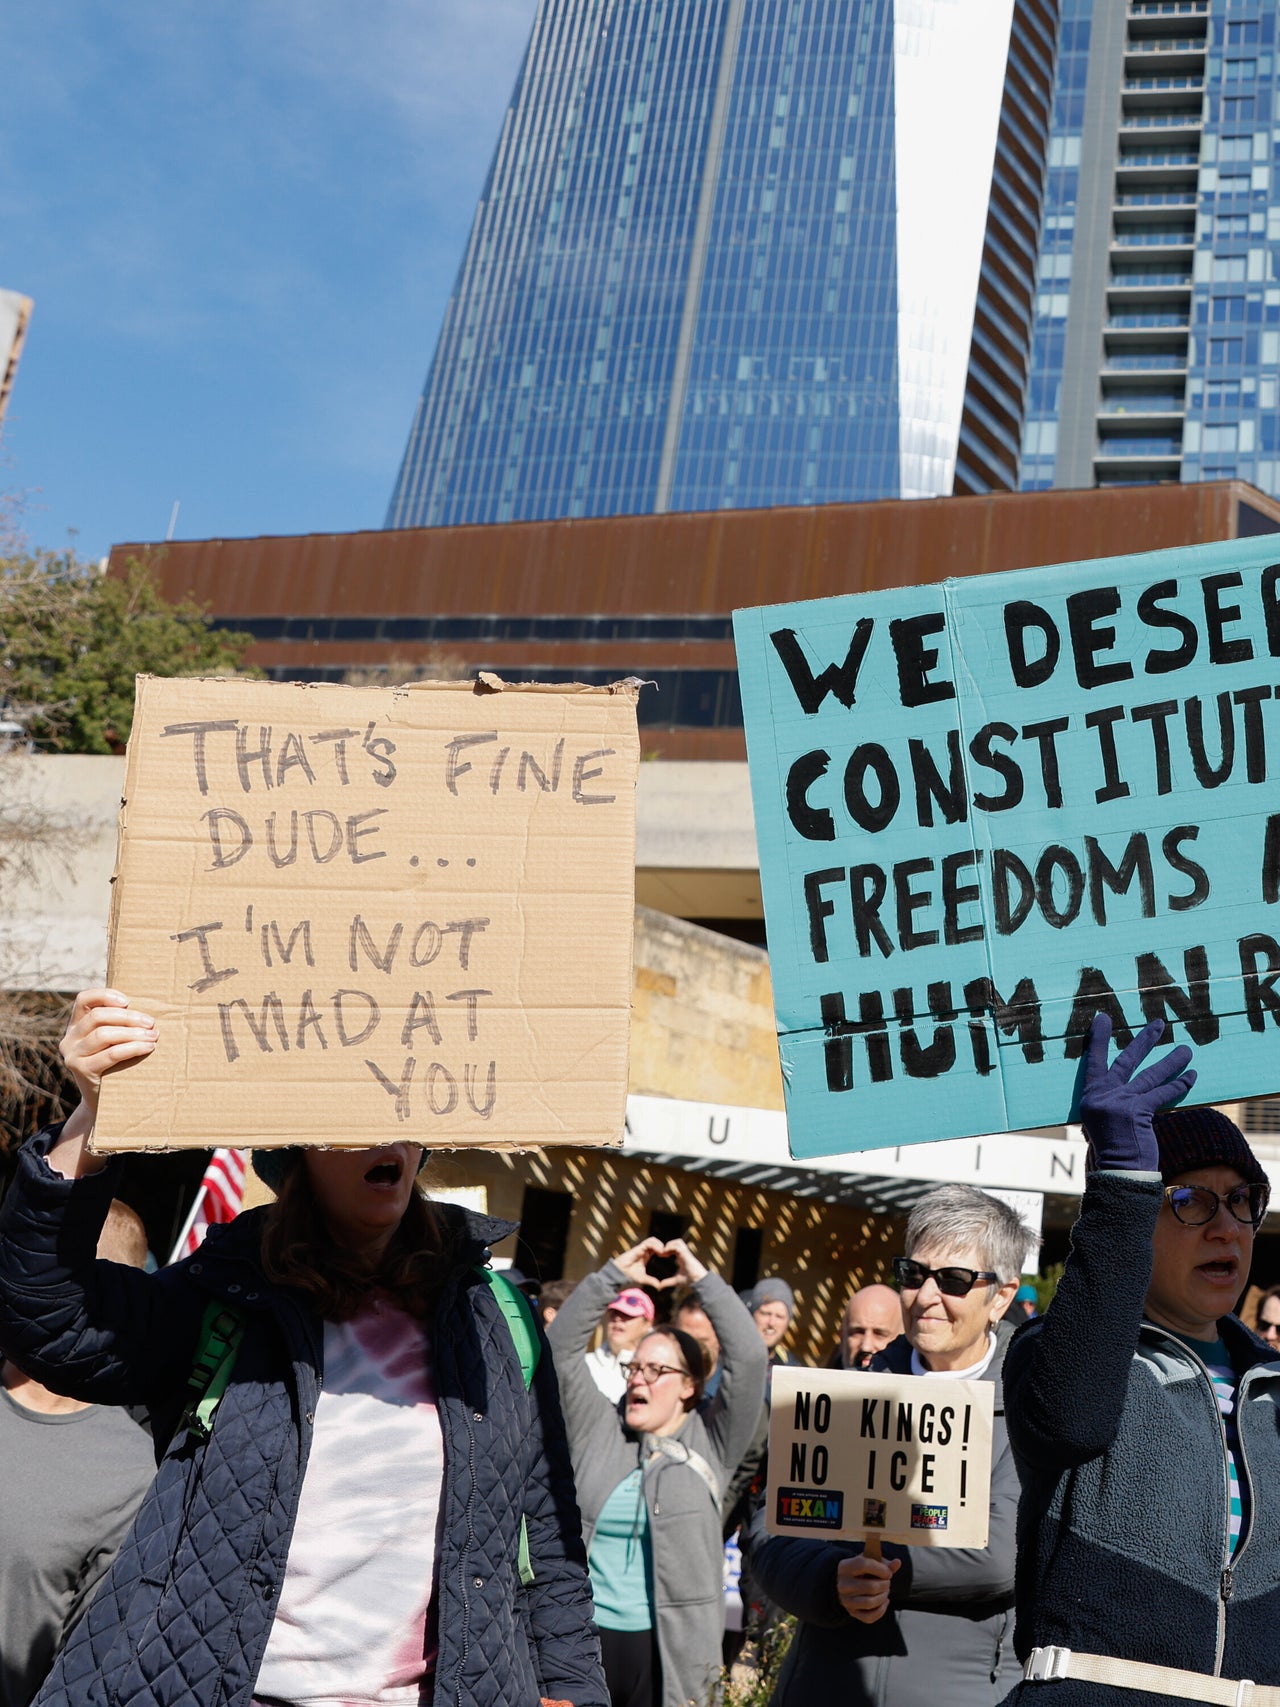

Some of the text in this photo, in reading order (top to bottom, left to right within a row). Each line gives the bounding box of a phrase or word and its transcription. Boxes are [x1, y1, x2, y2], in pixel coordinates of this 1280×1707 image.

[770, 611, 955, 715] WE
[159, 719, 617, 804] THAT'S FINE
[200, 807, 476, 872] DUDE...
[803, 824, 1211, 963] FREEDOMS
[169, 904, 491, 993] I'M NOT
[217, 987, 493, 1063] MAD AT
[820, 945, 1220, 1093] HUMAN
[365, 1056, 497, 1121] YOU
[794, 1391, 971, 1451] NO KINGS!
[790, 1442, 828, 1485] NO
[781, 1497, 839, 1519] TEXAN
[913, 1516, 937, 1525] PEACE
[920, 1508, 947, 1517] PEOPLE
